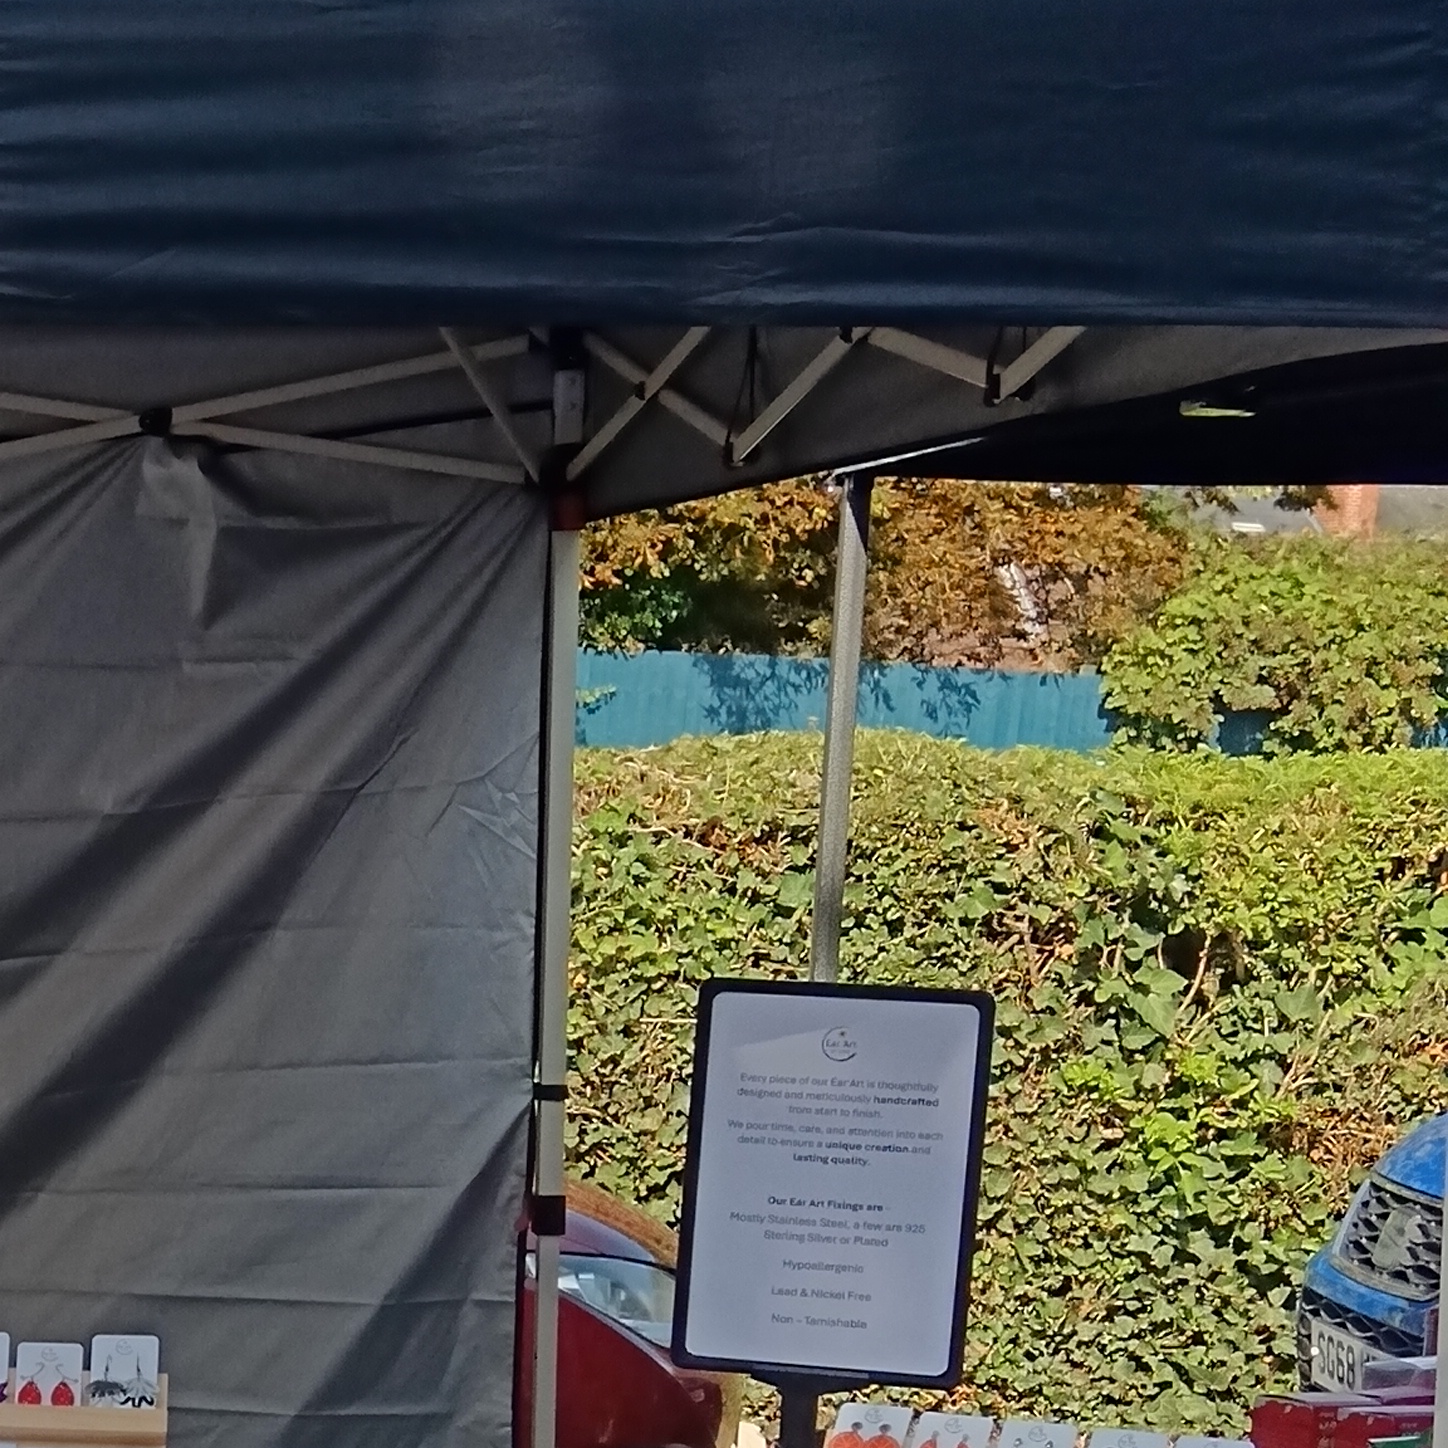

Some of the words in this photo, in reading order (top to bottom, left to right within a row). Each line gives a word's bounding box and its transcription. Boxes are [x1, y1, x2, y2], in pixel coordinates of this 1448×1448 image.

[740, 1073, 767, 1084] Every
[769, 1075, 796, 1085] piece
[799, 1076, 809, 1085] of
[867, 1080, 875, 1088] is
[877, 1081, 939, 1093] thoughtfully
[737, 1088, 782, 1098] designed
[784, 1090, 803, 1099] and
[805, 1093, 872, 1103] meticulously
[873, 1096, 939, 1107] handcrafted
[789, 1106, 812, 1114] from
[840, 1108, 850, 1117] to
[728, 1120, 744, 1128] We
[746, 1122, 770, 1131] pour
[826, 1126, 845, 1134] and
[848, 1127, 893, 1138] attention
[896, 1129, 915, 1140] into
[918, 1131, 943, 1141] each
[737, 1135, 766, 1144] detail
[781, 1140, 814, 1148] ensure
[825, 1141, 862, 1152] unique
[864, 1143, 909, 1152] creation
[911, 1146, 931, 1155] and
[768, 1196, 787, 1205] Our
[790, 1198, 806, 1206] Ear
[809, 1199, 825, 1208] Art
[828, 1200, 864, 1212] Fixings
[866, 1203, 883, 1212] are
[730, 1212, 766, 1224] Mostly
[768, 1214, 817, 1227] Stainless
[863, 1221, 883, 1231] few
[885, 1223, 902, 1232] are
[905, 1223, 926, 1234] 925
[764, 1230, 805, 1244] Sterling
[807, 1233, 837, 1244] Silver
[839, 1236, 851, 1245] or
[854, 1236, 888, 1247] Plated
[783, 1259, 864, 1275] Hypoallergenic
[771, 1286, 798, 1297] Lead
[800, 1289, 808, 1298] &
[811, 1289, 845, 1300] Nickel
[848, 1291, 871, 1301] Free
[771, 1313, 793, 1323] Non
[1317, 1330, 1355, 1390] SG68
